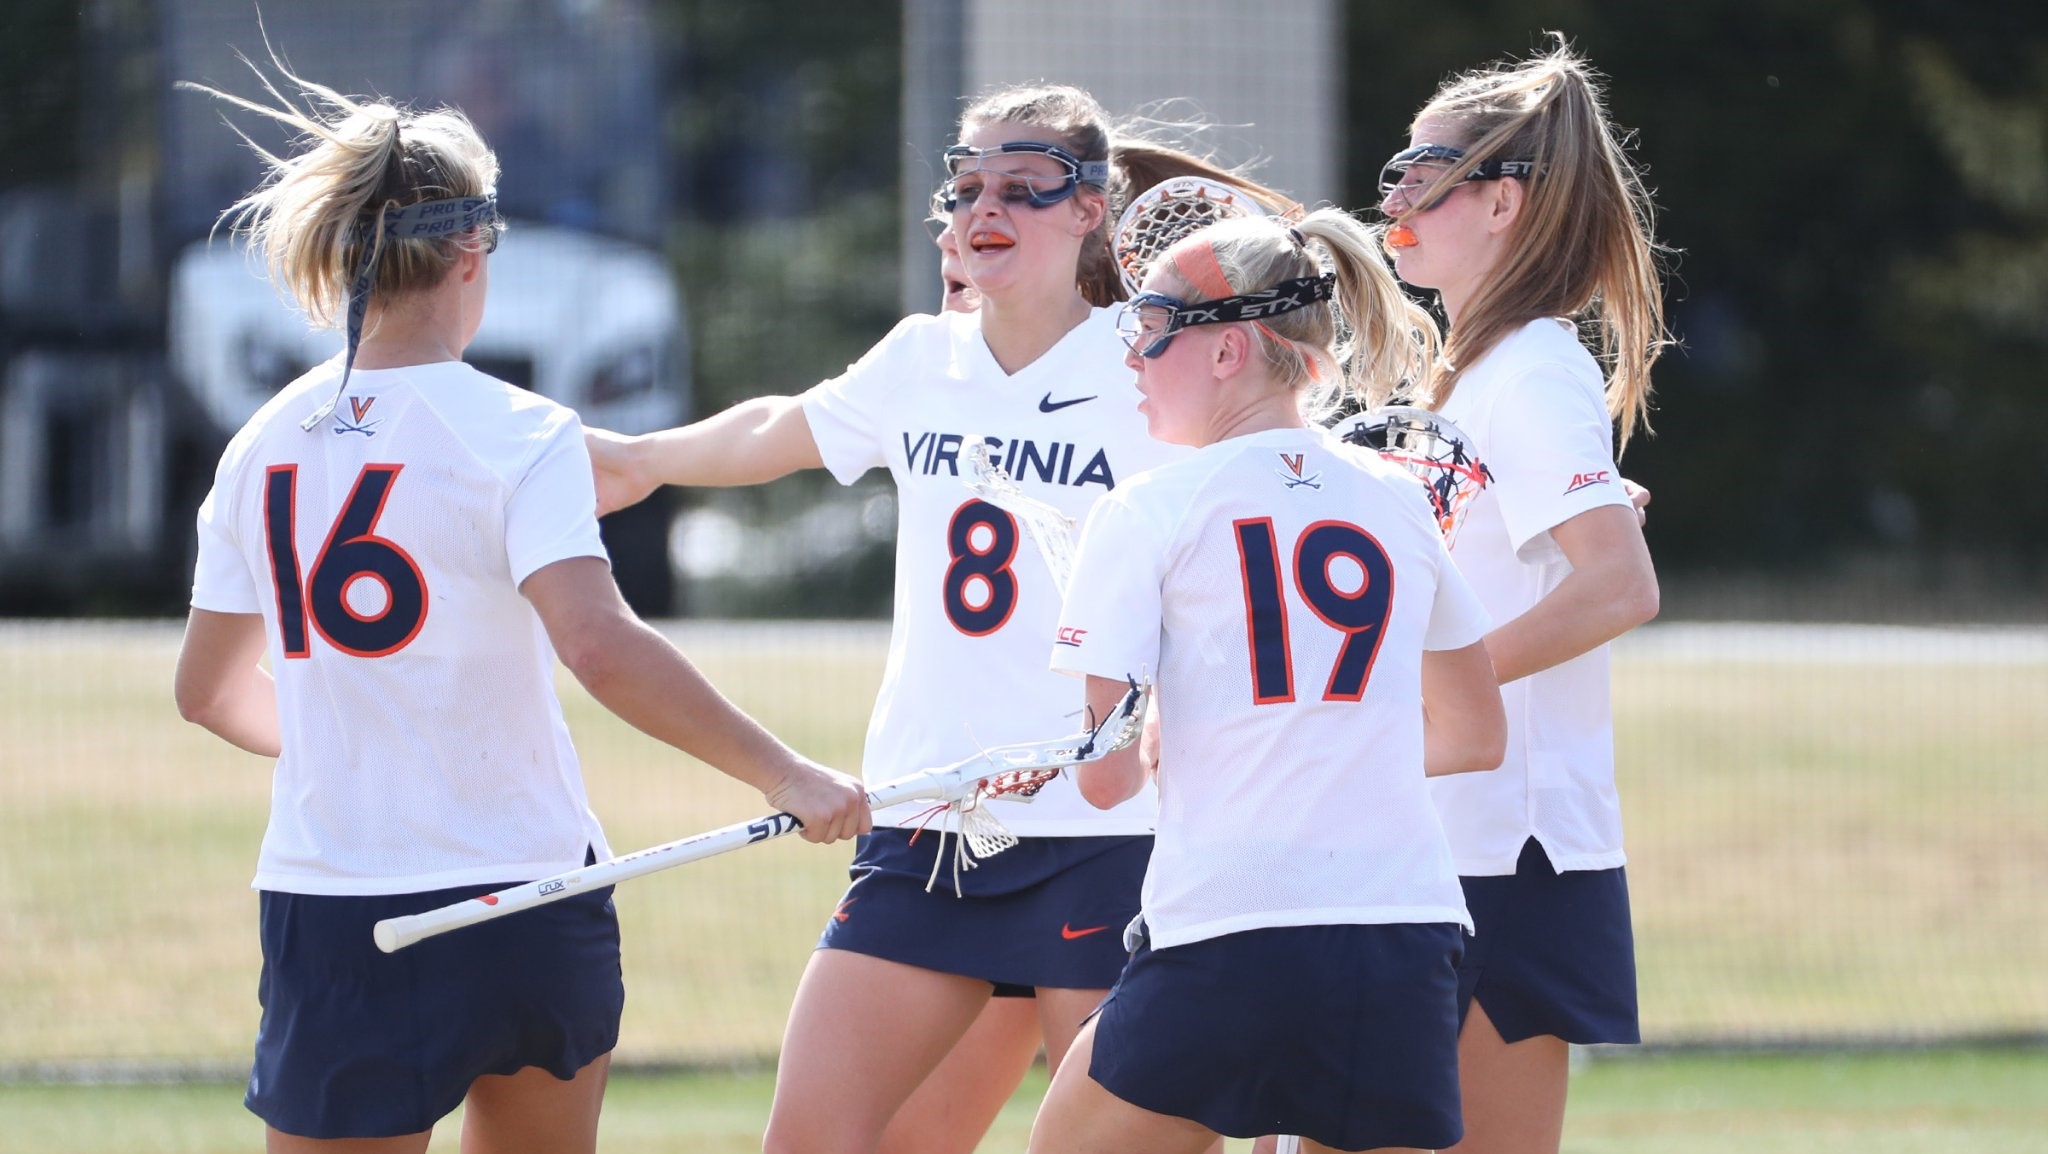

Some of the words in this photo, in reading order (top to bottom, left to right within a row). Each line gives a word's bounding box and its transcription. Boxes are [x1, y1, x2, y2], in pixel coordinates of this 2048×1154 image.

[1090, 164, 1108, 176] PR
[420, 202, 455, 218] PRO
[411, 219, 455, 234] PRO
[1177, 308, 1220, 324] TX
[1240, 292, 1302, 319] STX
[1567, 470, 1610, 491] ACC
[264, 463, 429, 659] 16
[943, 497, 1020, 638] 8
[1232, 516, 1395, 705] 19
[1057, 626, 1088, 643] CC
[747, 812, 804, 844] STX
